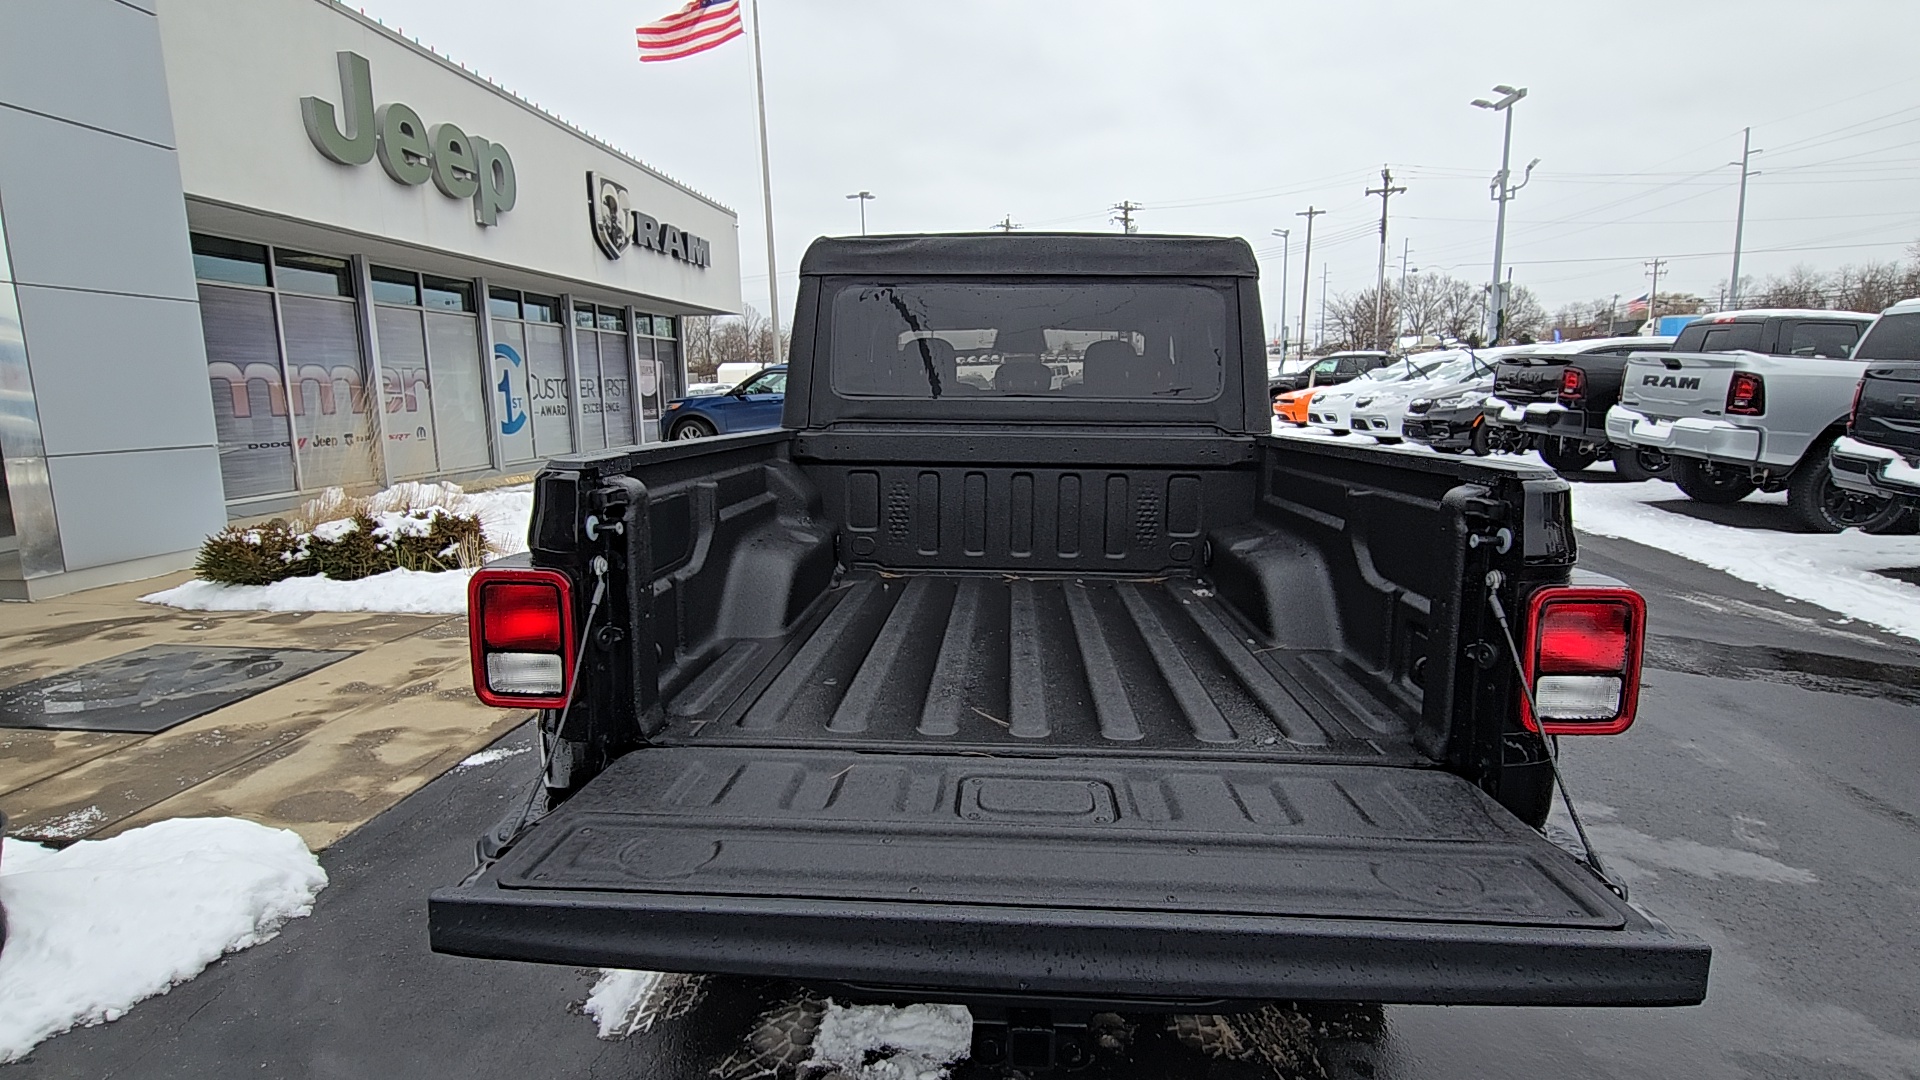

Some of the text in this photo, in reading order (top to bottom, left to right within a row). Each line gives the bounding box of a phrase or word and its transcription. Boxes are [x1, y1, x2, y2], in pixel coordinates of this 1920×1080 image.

[300, 50, 517, 227] Jeep
[631, 211, 711, 268] RAM
[1508, 371, 1544, 383] RAM
[1642, 375, 1701, 390] RAM
[526, 373, 596, 400] CUSTOER
[541, 402, 621, 416] AWARD EXCELENCE
[248, 441, 291, 450] DODG
[313, 435, 338, 449] Jeep
